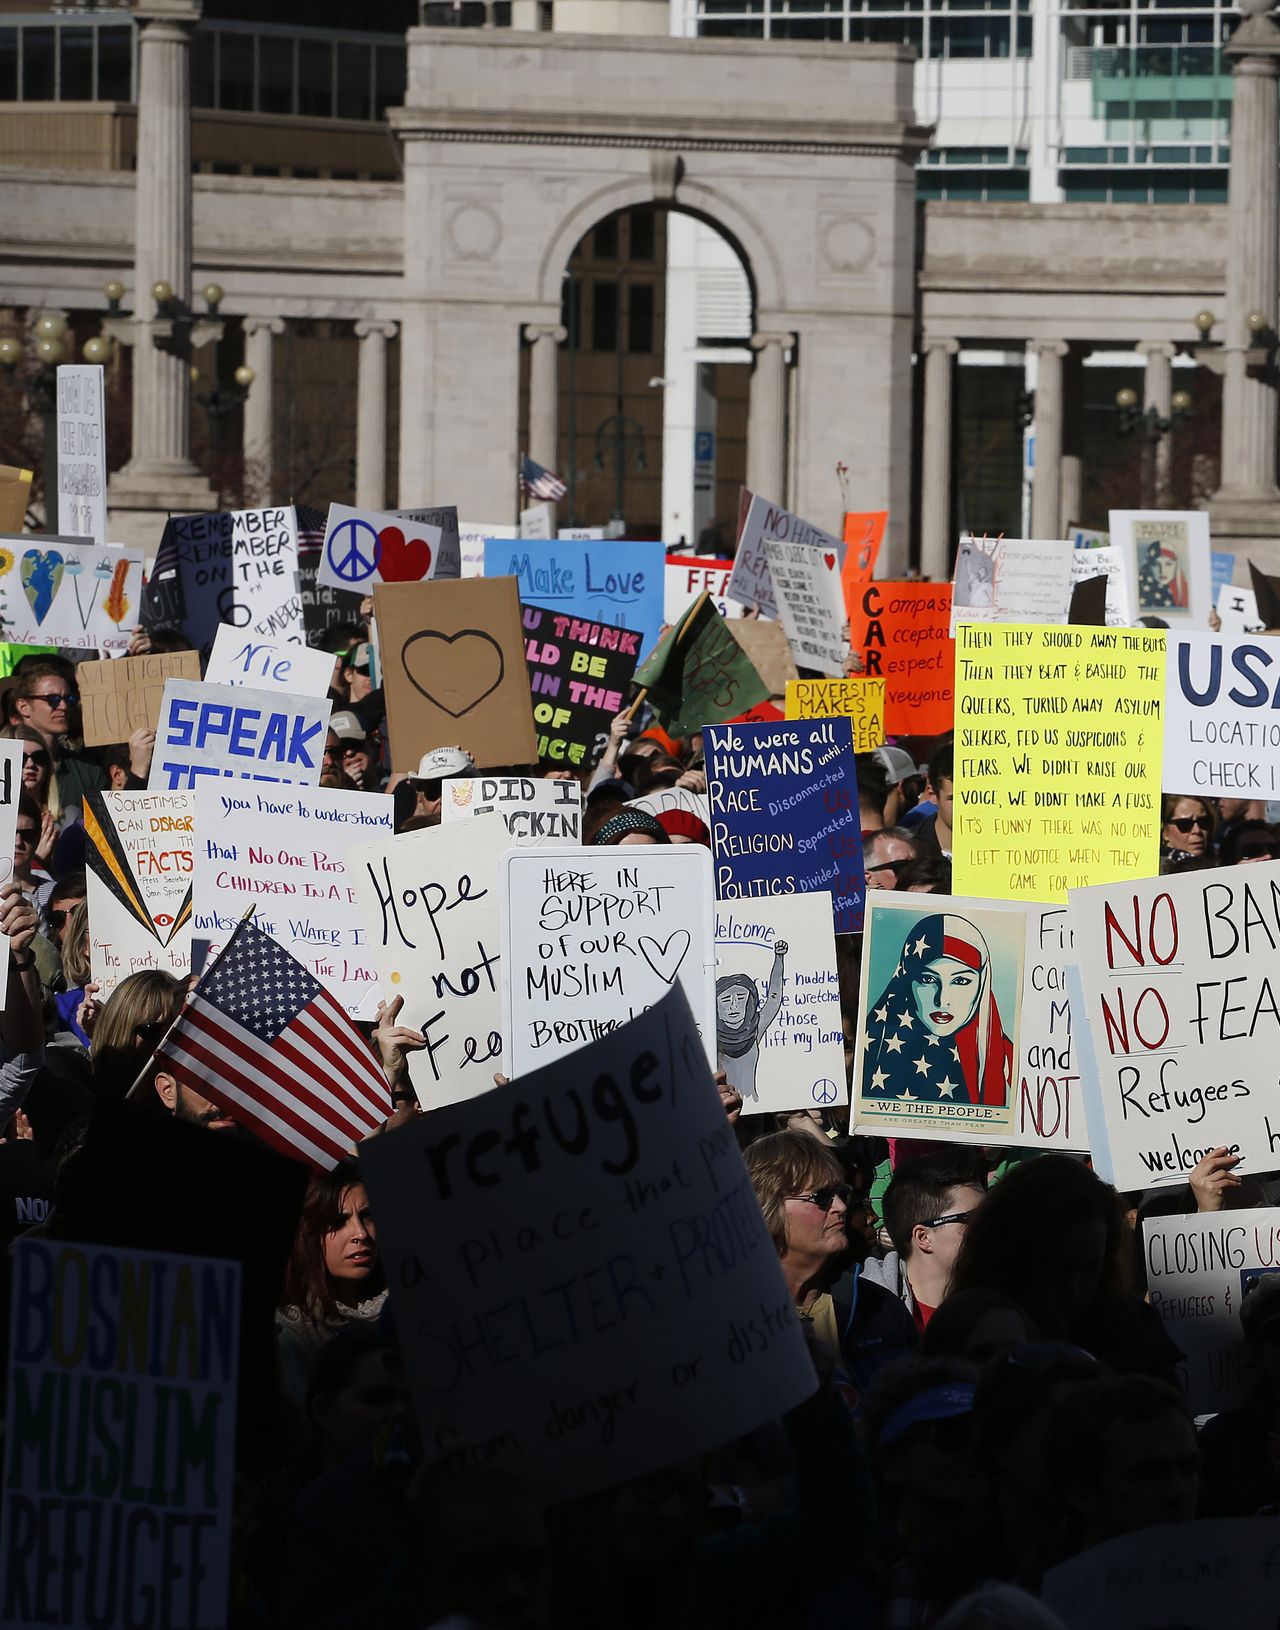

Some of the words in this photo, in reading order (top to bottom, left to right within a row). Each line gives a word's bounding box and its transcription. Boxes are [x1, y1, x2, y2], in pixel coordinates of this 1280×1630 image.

[176, 510, 286, 538] REMEMBER
[763, 508, 790, 539] NO
[177, 533, 293, 562] REMEMBER
[196, 570, 228, 587] ON
[239, 559, 286, 580] THE
[507, 553, 576, 595] Make
[584, 553, 647, 594] Love
[10, 632, 38, 649] We
[46, 636, 73, 649] are
[78, 632, 99, 649] all
[103, 637, 129, 649] one
[553, 616, 640, 657] THINK
[959, 625, 993, 650] THEN
[1002, 631, 1034, 649] THEY
[1042, 631, 1083, 650] SHOOED
[1091, 634, 1118, 651] AWAY
[1122, 635, 1142, 651] THE
[1143, 636, 1167, 655] BUMS
[569, 651, 608, 679] BE
[531, 672, 562, 697] IN
[567, 681, 623, 714] THE
[796, 682, 886, 705] DIVERSITY
[800, 698, 866, 714] MAKES
[961, 695, 1016, 718] QUEERS,
[1022, 697, 1068, 715] TURNED
[1072, 698, 1103, 715] AWAY
[1114, 699, 1160, 721] ASYLUM
[533, 702, 572, 729] OF
[167, 697, 324, 768] SPEAK
[709, 727, 745, 754] We
[754, 733, 801, 750] were
[810, 723, 836, 745] all
[713, 747, 814, 780] HUMANS
[1193, 760, 1262, 790] CHECK
[222, 795, 251, 820] you
[258, 794, 293, 816] have
[297, 800, 311, 819] to
[482, 777, 537, 802] DID
[555, 778, 580, 805] I
[710, 780, 763, 816] RACE
[769, 766, 846, 818] Disconnected
[118, 820, 145, 837] CAN
[126, 836, 158, 853] WITH
[714, 822, 795, 861] RELIGION
[798, 812, 855, 860] Separated
[137, 849, 194, 881] FACTS
[970, 849, 1002, 867] LEFT
[1005, 850, 1022, 866] TO
[1024, 849, 1061, 866] NOTICE
[1069, 849, 1101, 866] WHEN
[1109, 850, 1141, 869] THEY
[215, 871, 298, 900] CHILDREN
[543, 868, 599, 898] HERE
[617, 867, 639, 894] IN
[717, 865, 797, 901] POLITICS
[800, 861, 841, 895] Divided
[367, 856, 489, 961] Hope
[539, 886, 675, 932] SUPPORT
[538, 935, 577, 960] OF
[580, 930, 638, 959] OUR
[1104, 892, 1179, 970] NO
[432, 941, 502, 999] not
[527, 962, 625, 1002] MUSLIM
[778, 1012, 819, 1027] those
[1100, 987, 1170, 1055] NO
[1028, 1035, 1071, 1071] and
[1117, 1058, 1251, 1124] Refugees
[878, 1102, 902, 1114] WE
[907, 1103, 935, 1115] THE
[939, 1105, 993, 1119] PEOPLE
[1021, 1076, 1081, 1140] NOT
[1149, 1227, 1247, 1277] CLOSING
[14, 1240, 236, 1383] BOSNIAN
[1150, 1289, 1216, 1322] REFUGEES
[416, 1252, 657, 1395] SHELTER
[7, 1366, 224, 1509] MUSLIM
[2, 1494, 220, 1630] REFUGEE
